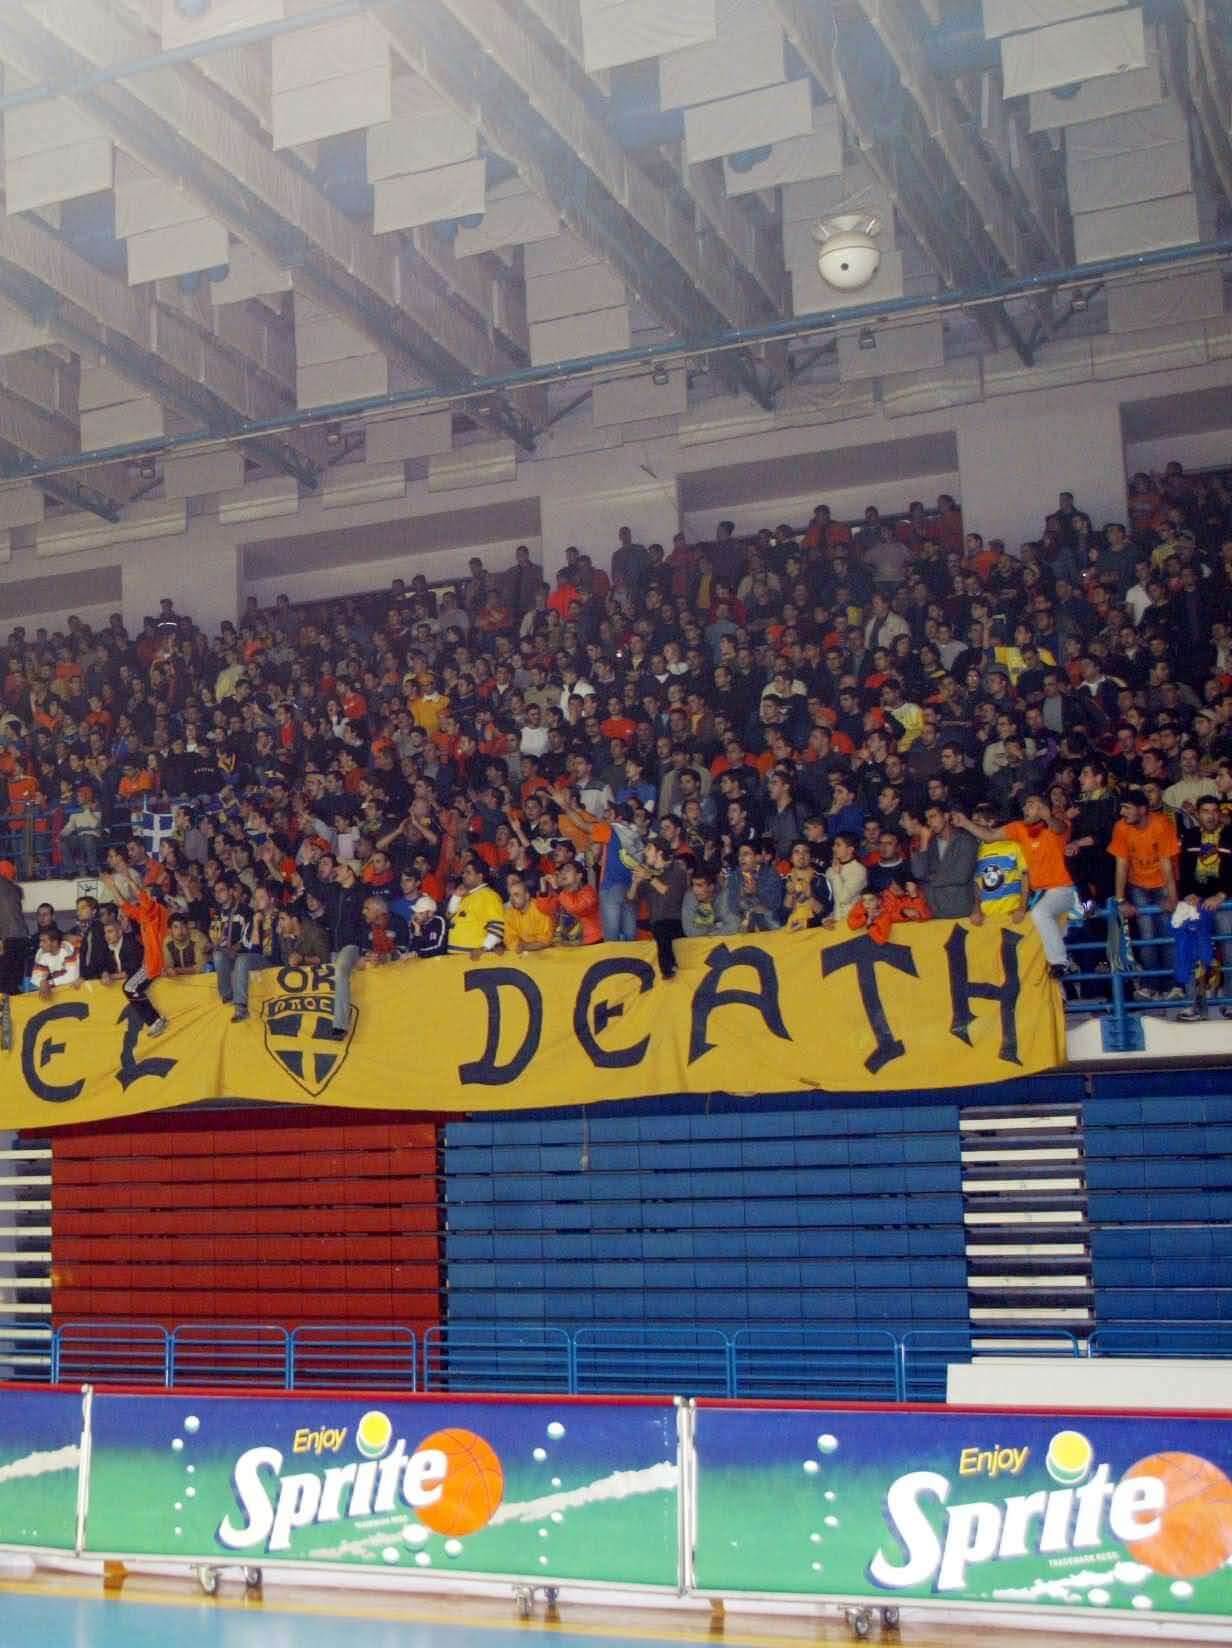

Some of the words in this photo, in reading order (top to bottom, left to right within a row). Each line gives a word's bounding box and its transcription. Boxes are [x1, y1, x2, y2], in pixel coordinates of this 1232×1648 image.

[459, 922, 1025, 1086] DEATH
[215, 1438, 448, 1552] Sprite
[292, 1425, 347, 1455] Enjoy
[959, 1444, 1030, 1478] Enjoy
[866, 1463, 1166, 1593] Sprite
